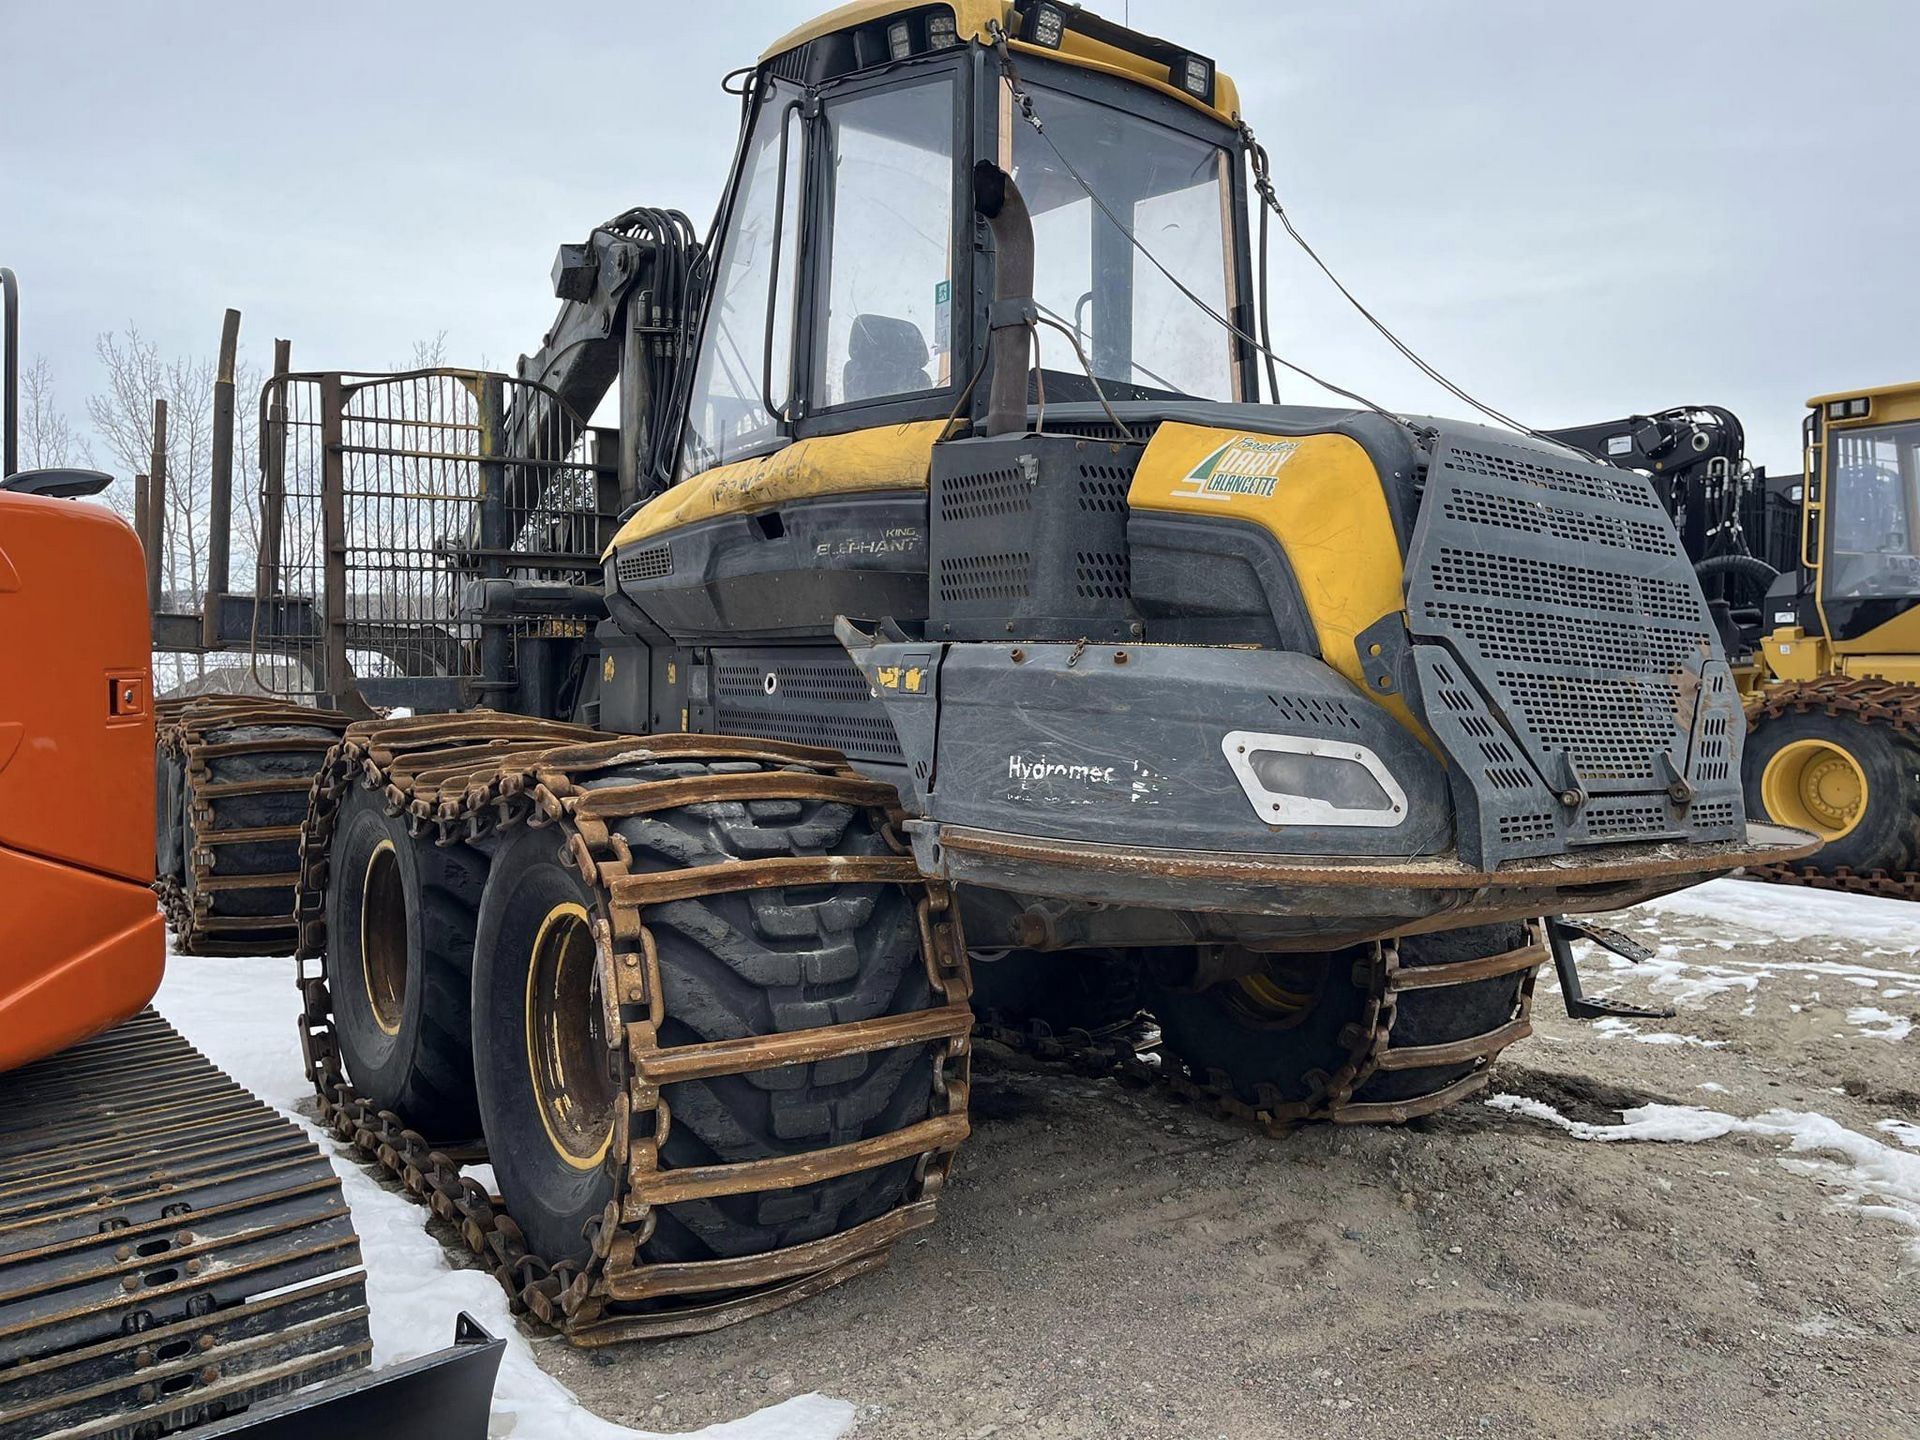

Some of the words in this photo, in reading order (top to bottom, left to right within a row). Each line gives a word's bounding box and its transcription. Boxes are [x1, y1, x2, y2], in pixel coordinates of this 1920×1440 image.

[1206, 473, 1279, 496] LALANCETTE
[885, 527, 917, 538] KING
[816, 537, 921, 556] EEPHANT
